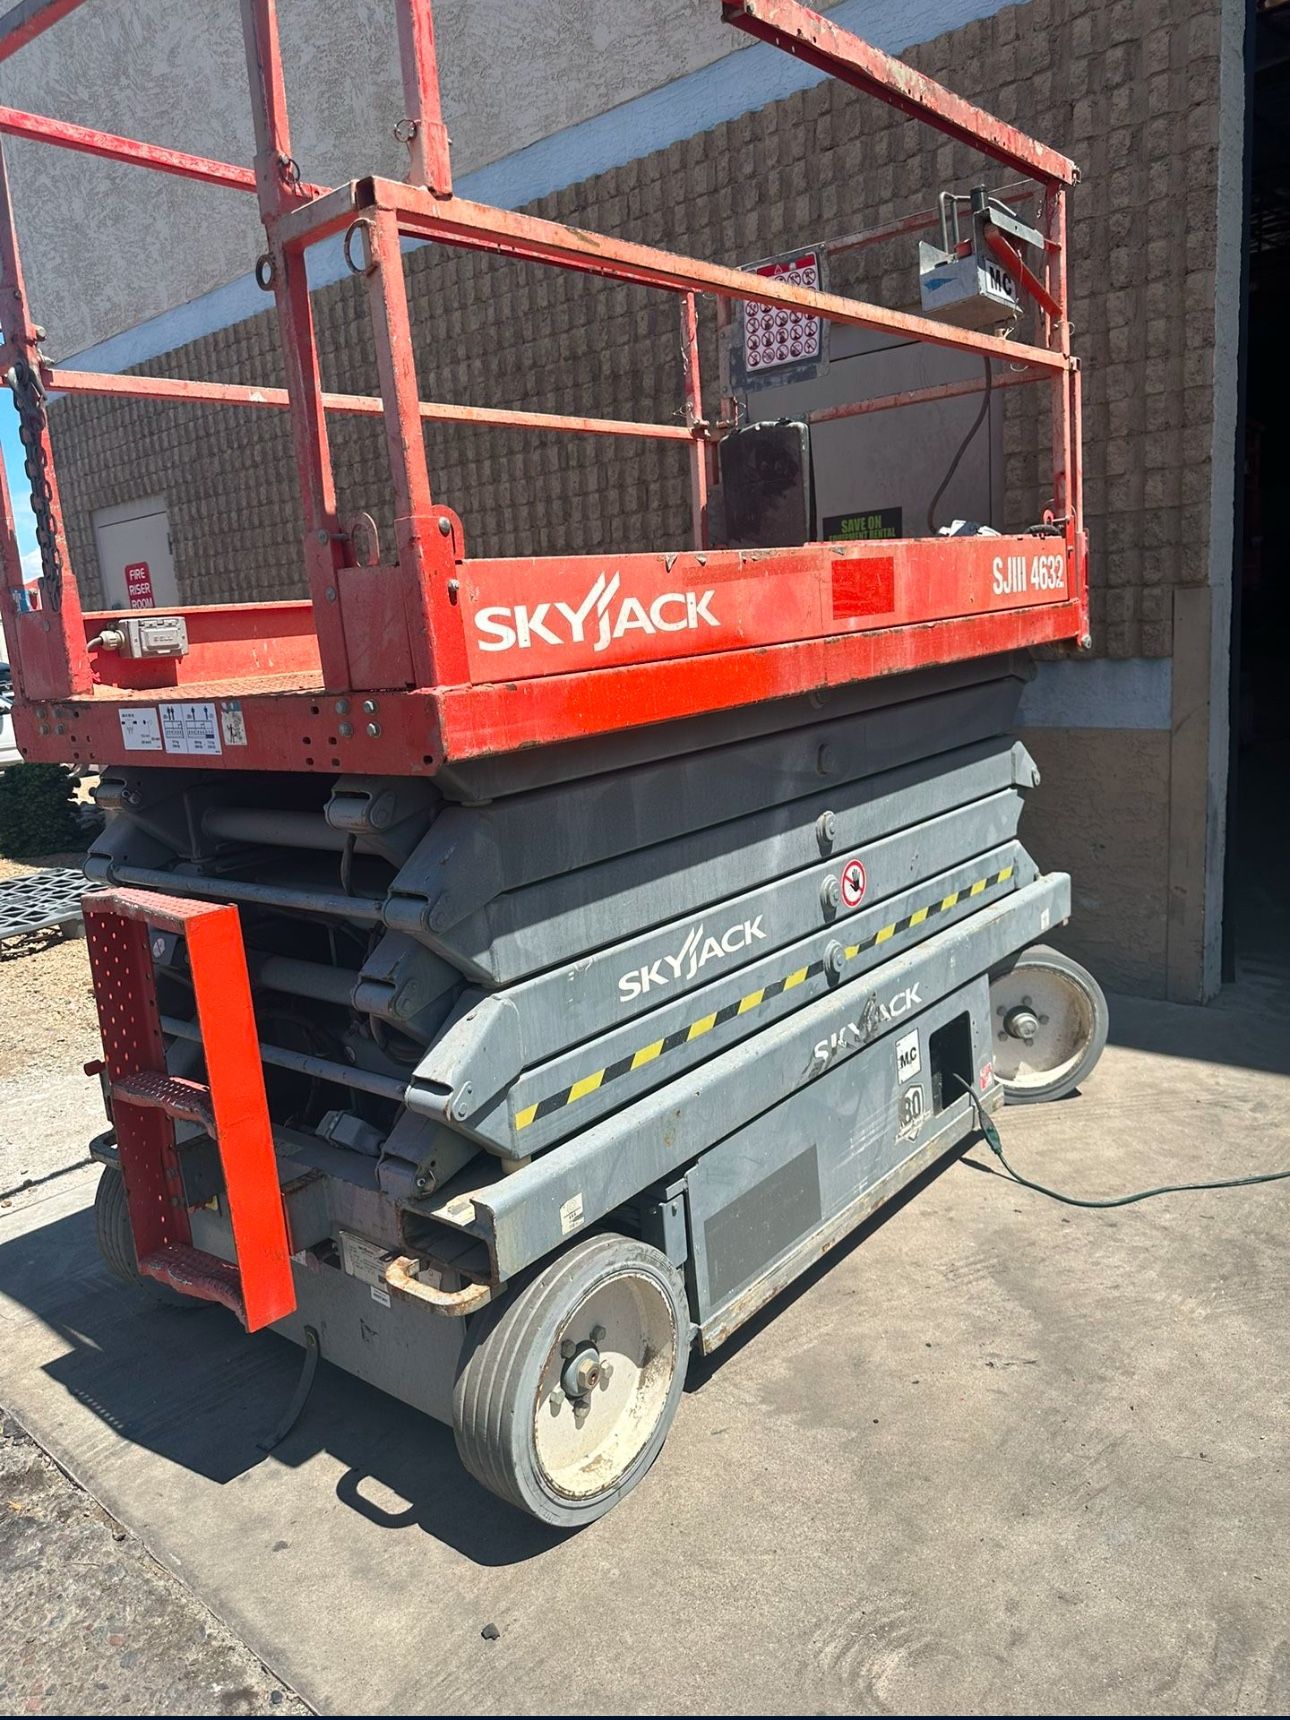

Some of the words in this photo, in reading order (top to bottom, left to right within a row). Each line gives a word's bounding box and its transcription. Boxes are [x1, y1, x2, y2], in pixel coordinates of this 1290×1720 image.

[989, 266, 1012, 296] MC
[841, 517, 866, 533] SAVE
[868, 515, 882, 529] ON
[129, 568, 146, 581] FIRE
[992, 556, 1027, 595] SJIII
[1030, 554, 1065, 590] 4632
[129, 582, 151, 596] RISER
[131, 597, 153, 609] ROOM
[474, 570, 721, 652] SKYJACK
[618, 914, 767, 1003] SKYJACK
